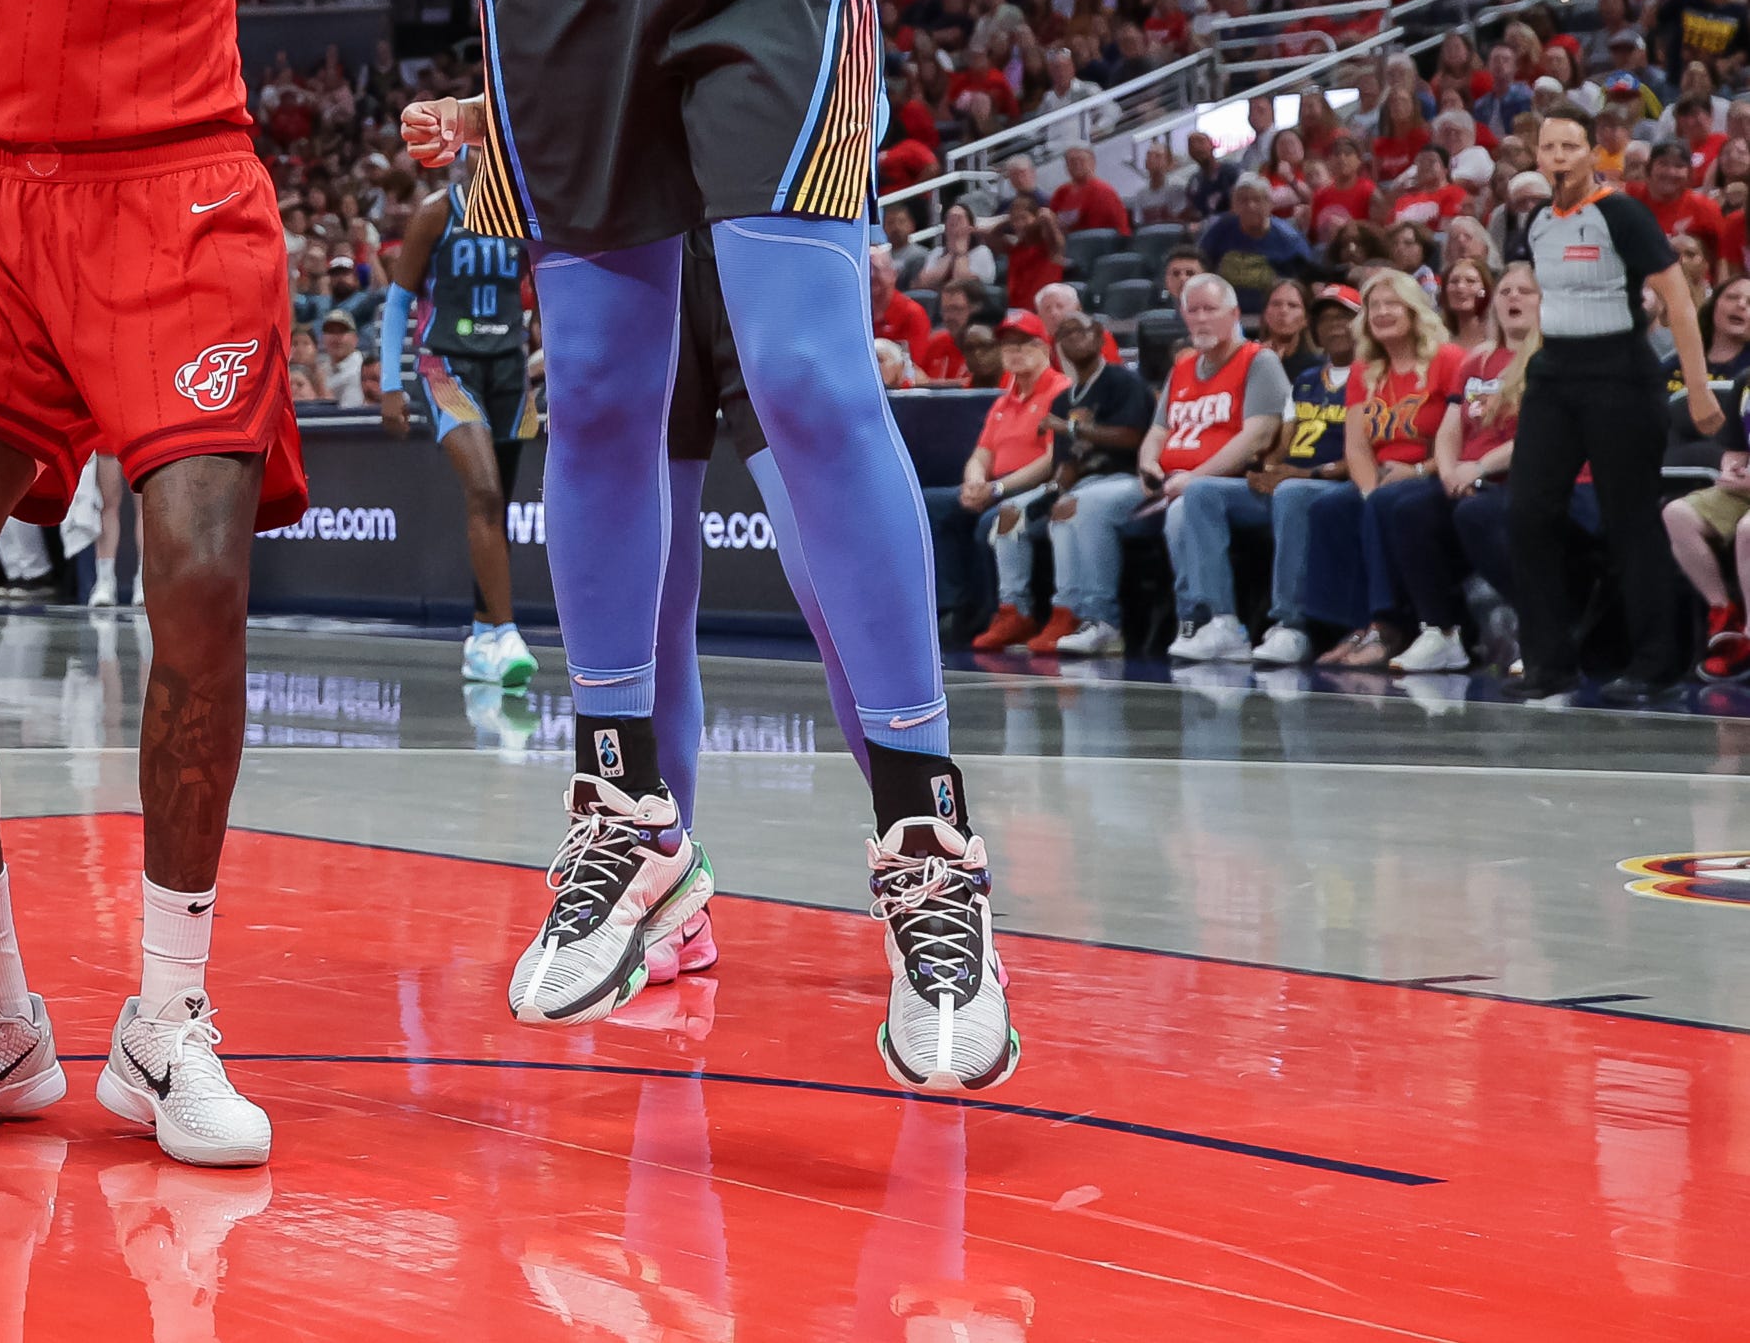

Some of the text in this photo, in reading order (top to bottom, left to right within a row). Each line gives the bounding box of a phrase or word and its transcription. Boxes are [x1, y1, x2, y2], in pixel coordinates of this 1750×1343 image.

[452, 237, 519, 279] ATL
[471, 284, 498, 318] 10
[1168, 390, 1233, 429] FEVER
